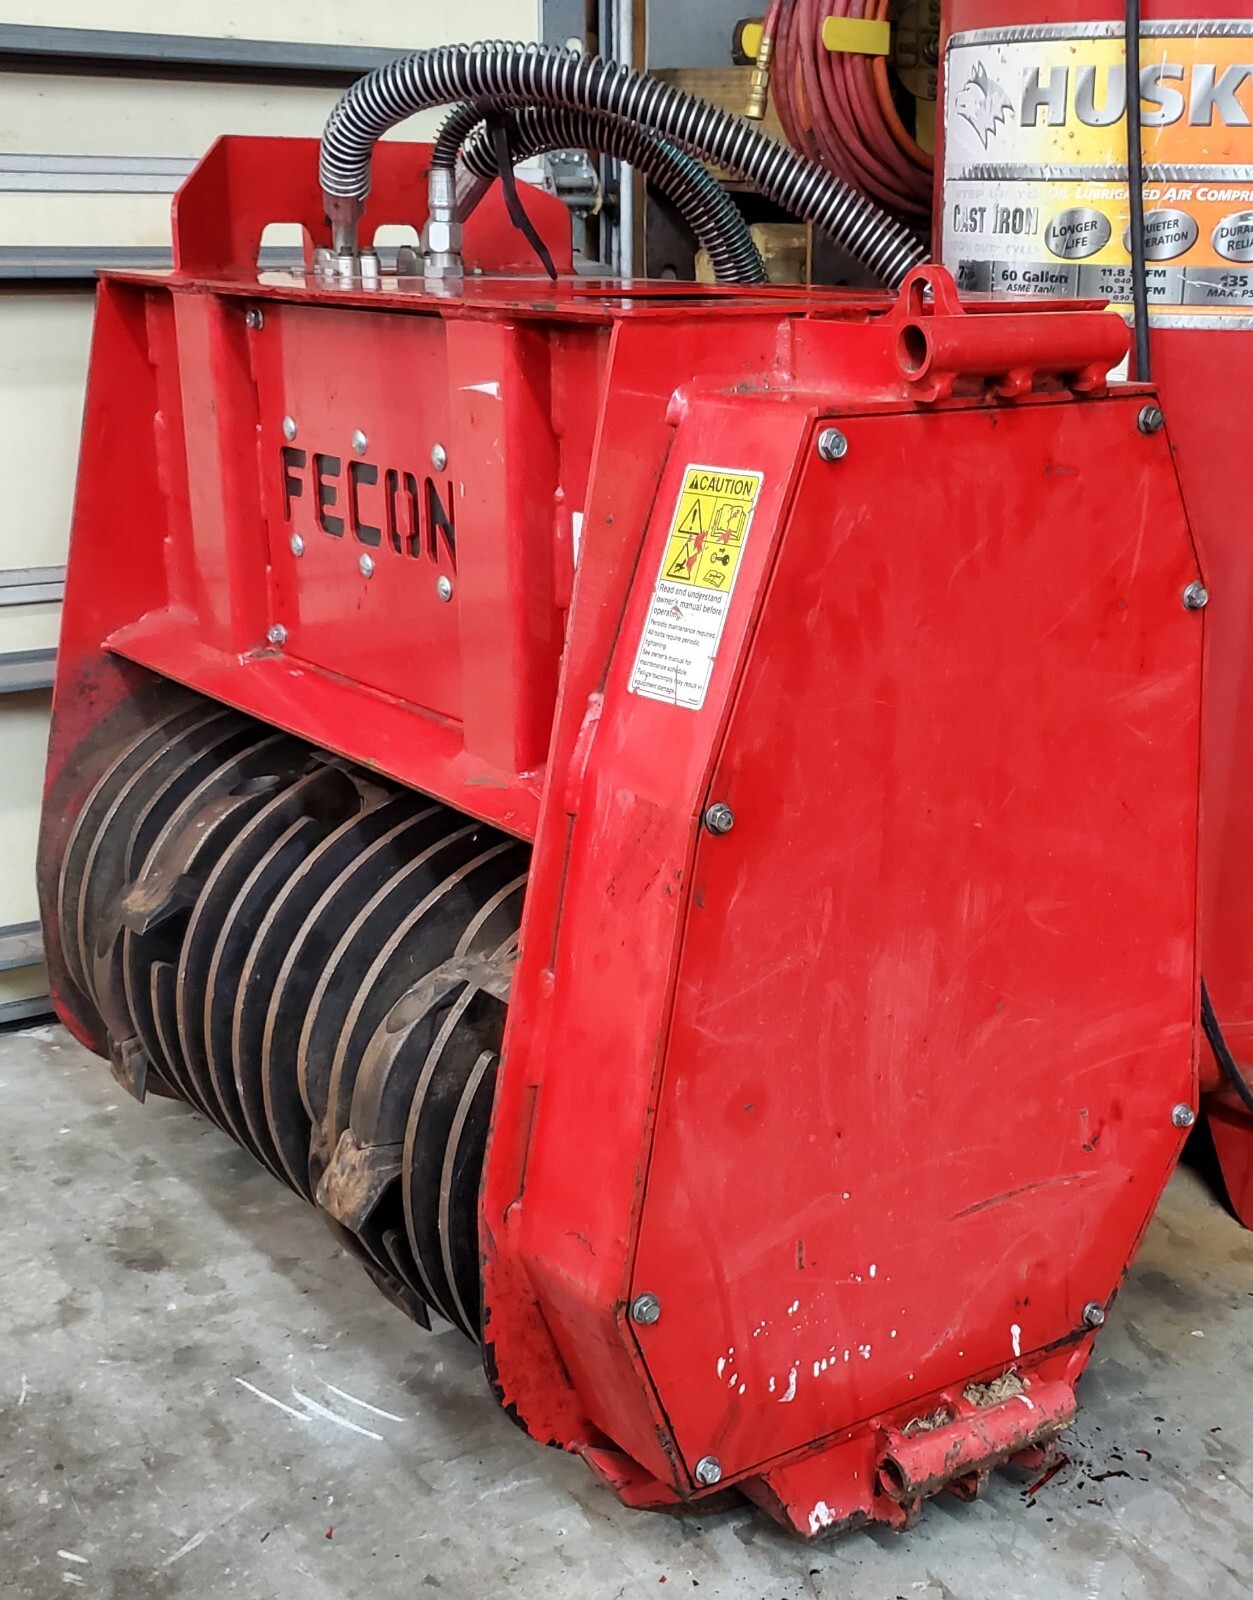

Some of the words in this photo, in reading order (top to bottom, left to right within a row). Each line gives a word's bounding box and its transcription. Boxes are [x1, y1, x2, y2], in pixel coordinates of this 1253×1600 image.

[1020, 64, 1253, 127] HUSK
[1162, 187, 1192, 201] AIR
[953, 204, 986, 233] CAST
[992, 203, 1039, 235] IRON
[1144, 219, 1179, 234] UIETER
[1052, 220, 1098, 238] LONGER
[1066, 236, 1088, 250] LIFE
[1144, 231, 1188, 248] ERATION
[1001, 270, 1018, 281] 60
[1022, 270, 1068, 284] Gallon
[1100, 268, 1125, 277] 11.8
[1219, 274, 1248, 287] 135
[1006, 283, 1031, 293] ASME
[1033, 283, 1056, 294] Tank
[1098, 285, 1125, 294] 10.3
[700, 475, 753, 497] CAUTION
[280, 446, 457, 576] FECON
[660, 583, 675, 594] Read
[675, 588, 688, 597] and
[687, 590, 722, 604] understand
[656, 596, 679, 606] owner's
[680, 601, 703, 612] manual
[703, 605, 722, 616] before
[651, 618, 668, 628] Periodic
[668, 624, 696, 635] maintenance
[665, 634, 681, 643] require
[681, 637, 701, 647] periodic
[642, 648, 650, 656] See
